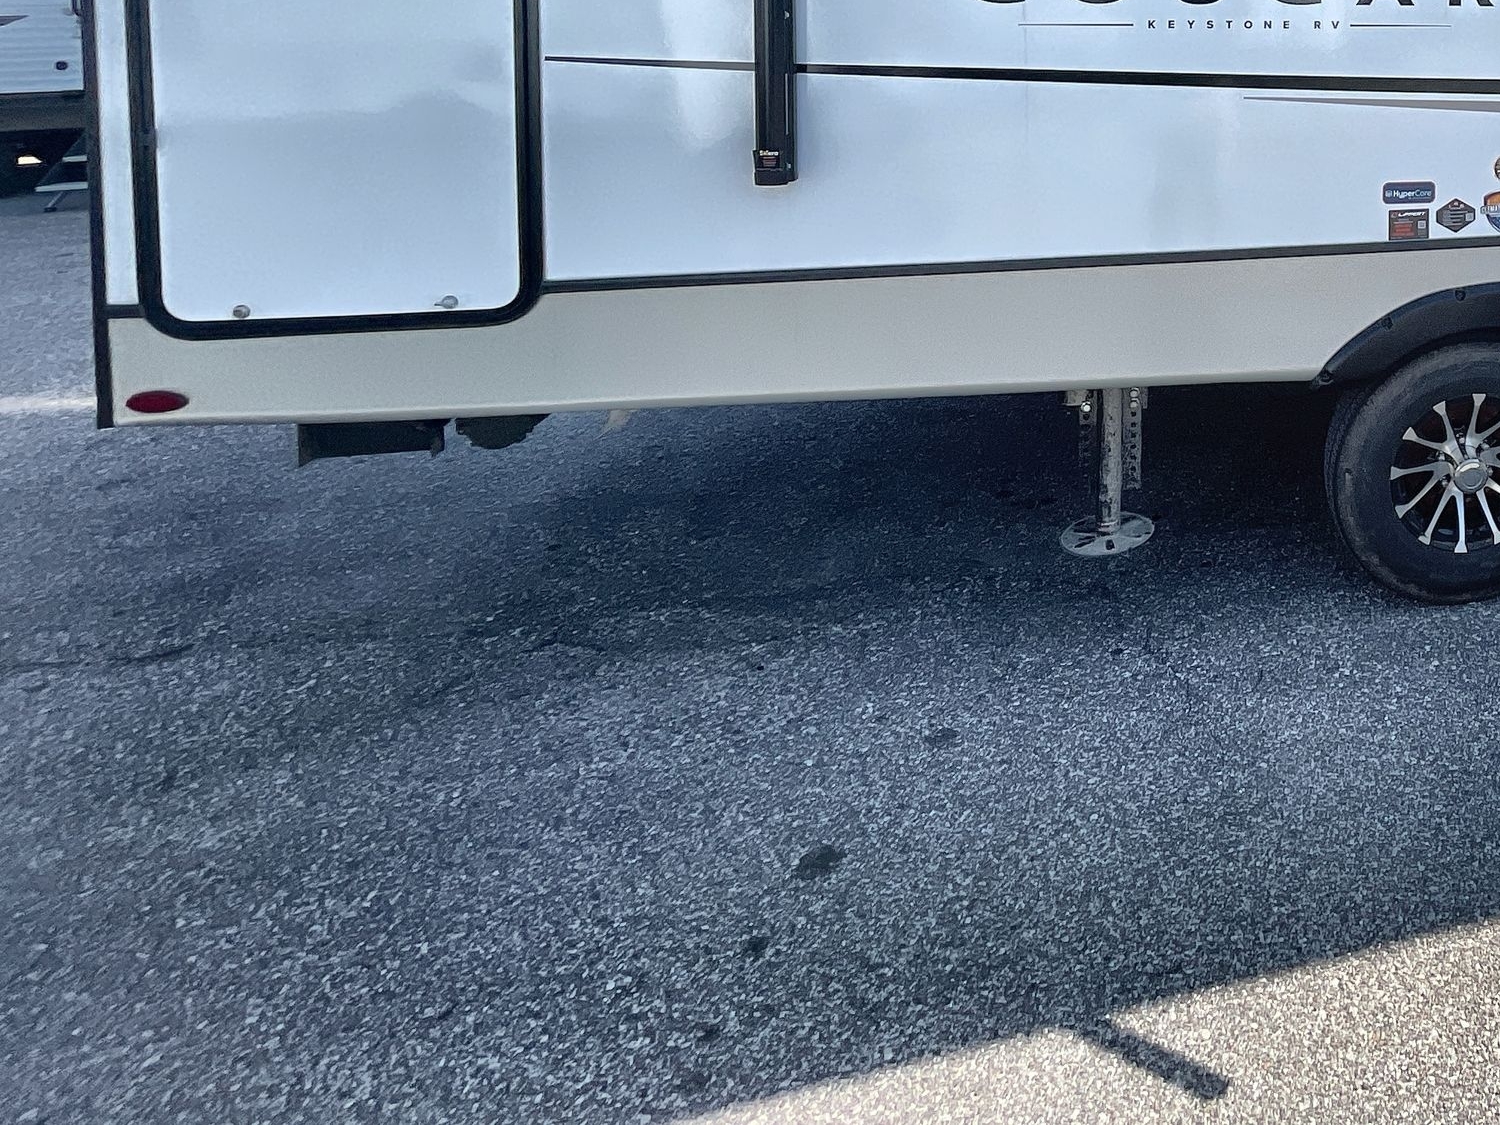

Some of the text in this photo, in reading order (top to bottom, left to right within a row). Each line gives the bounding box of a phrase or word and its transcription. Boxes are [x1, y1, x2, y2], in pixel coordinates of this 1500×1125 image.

[1147, 20, 1341, 30] KEYSTONE RV
[1393, 189, 1432, 199] HyperCore
